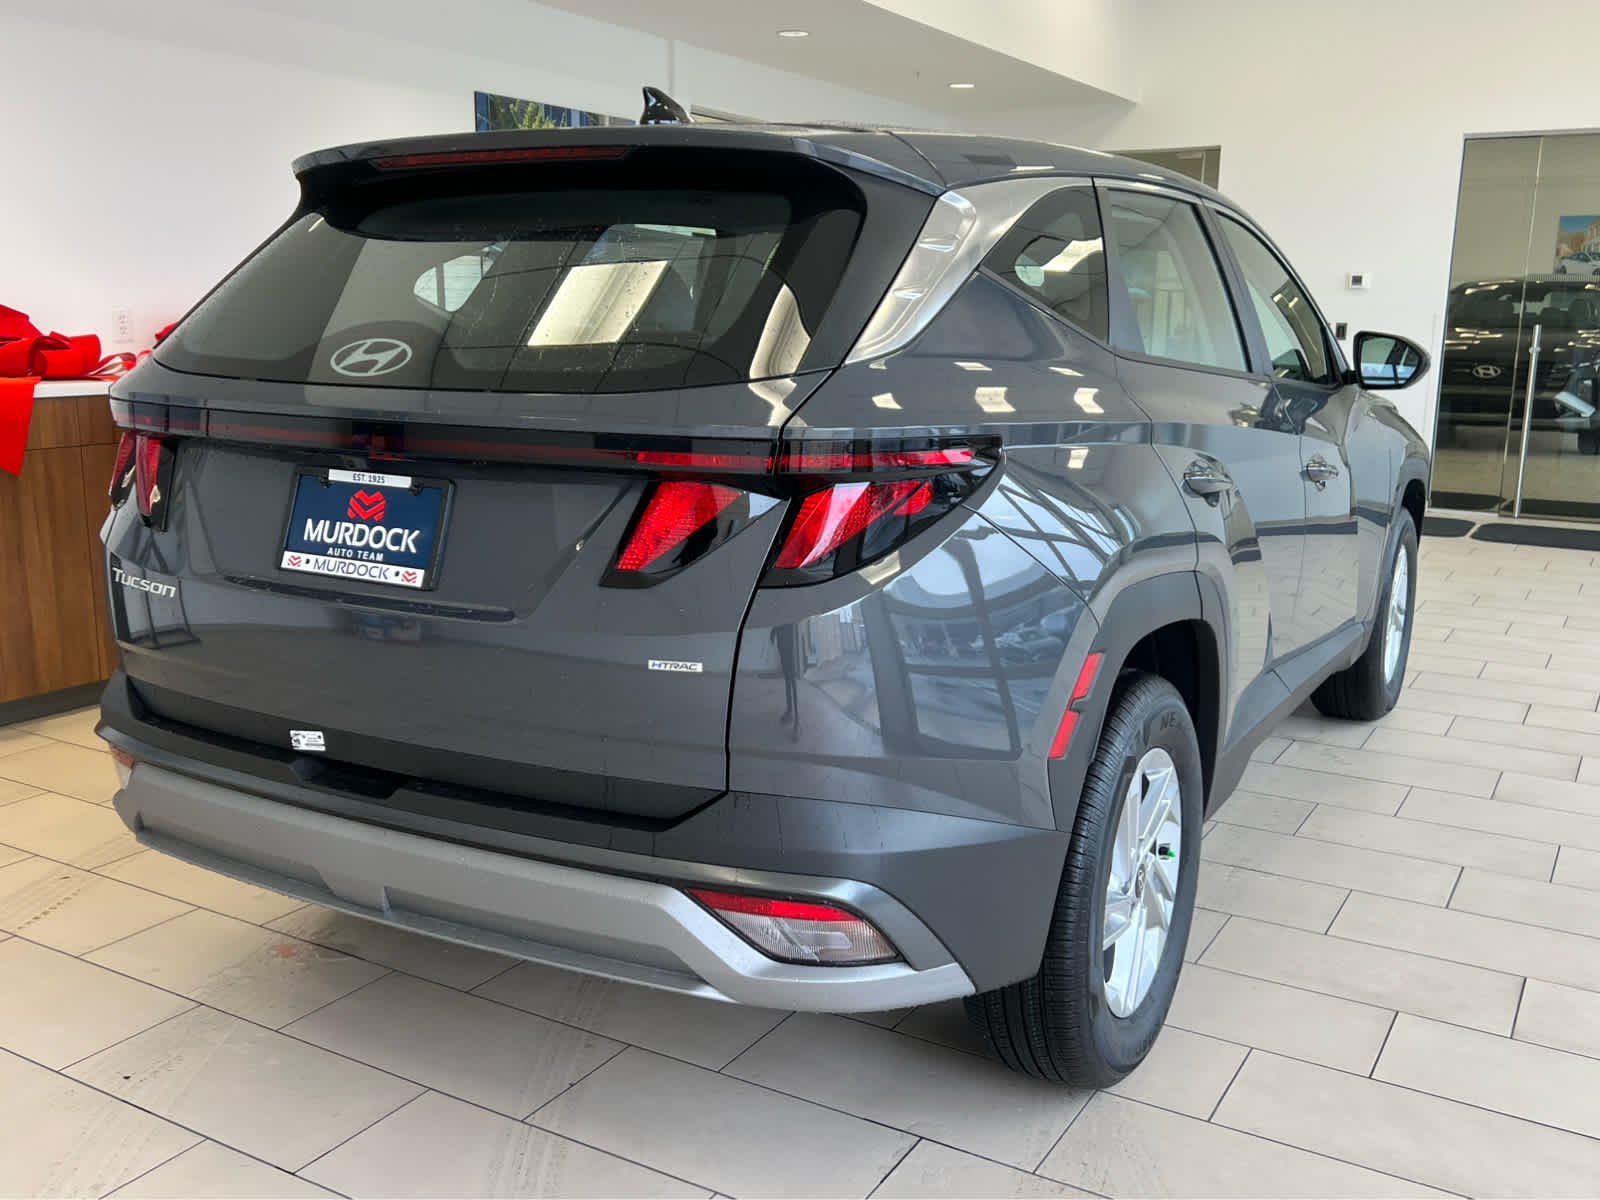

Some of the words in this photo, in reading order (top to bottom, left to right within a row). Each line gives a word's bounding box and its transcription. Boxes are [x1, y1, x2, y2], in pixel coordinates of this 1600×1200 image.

[367, 474, 386, 484] 1925
[303, 518, 420, 553] MURDOCK
[327, 547, 354, 558] AUTO
[357, 551, 384, 562] TEAM
[313, 558, 389, 580] MURDOCK
[650, 661, 698, 671] HTRAC
